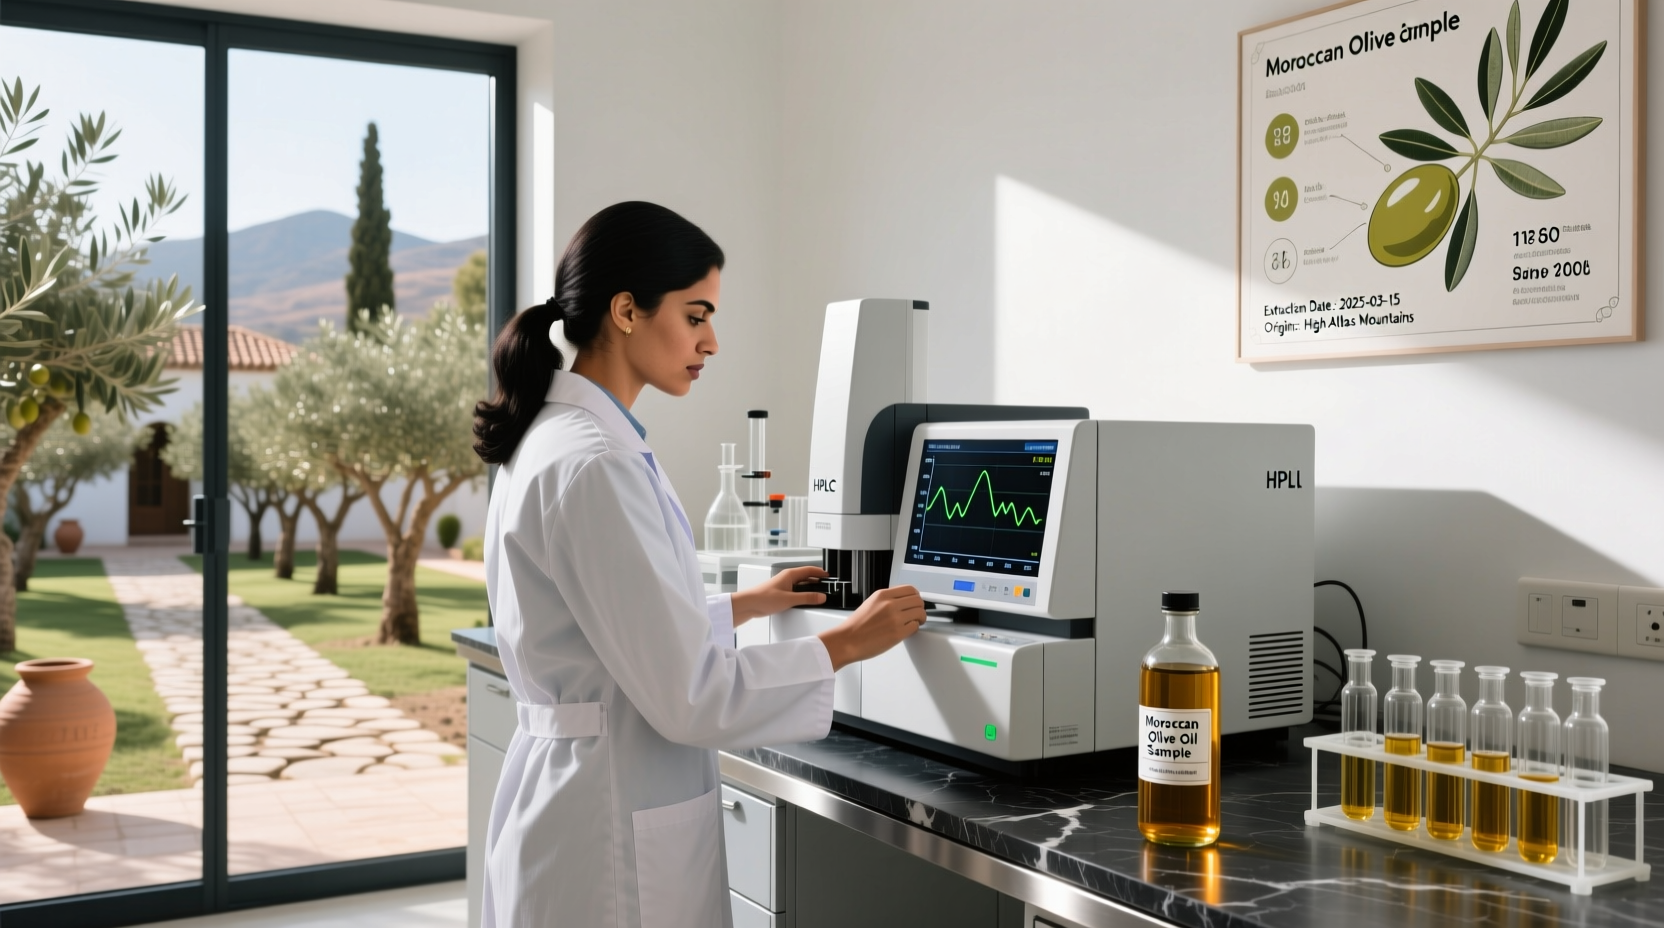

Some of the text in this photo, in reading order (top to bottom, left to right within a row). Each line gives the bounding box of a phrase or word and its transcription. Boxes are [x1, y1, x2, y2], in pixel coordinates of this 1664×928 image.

[1266, 45, 1344, 77] Moroccan
[1349, 31, 1395, 55] Olive
[1339, 293, 1400, 310] 2025-03-15
[813, 478, 837, 492] HPLC
